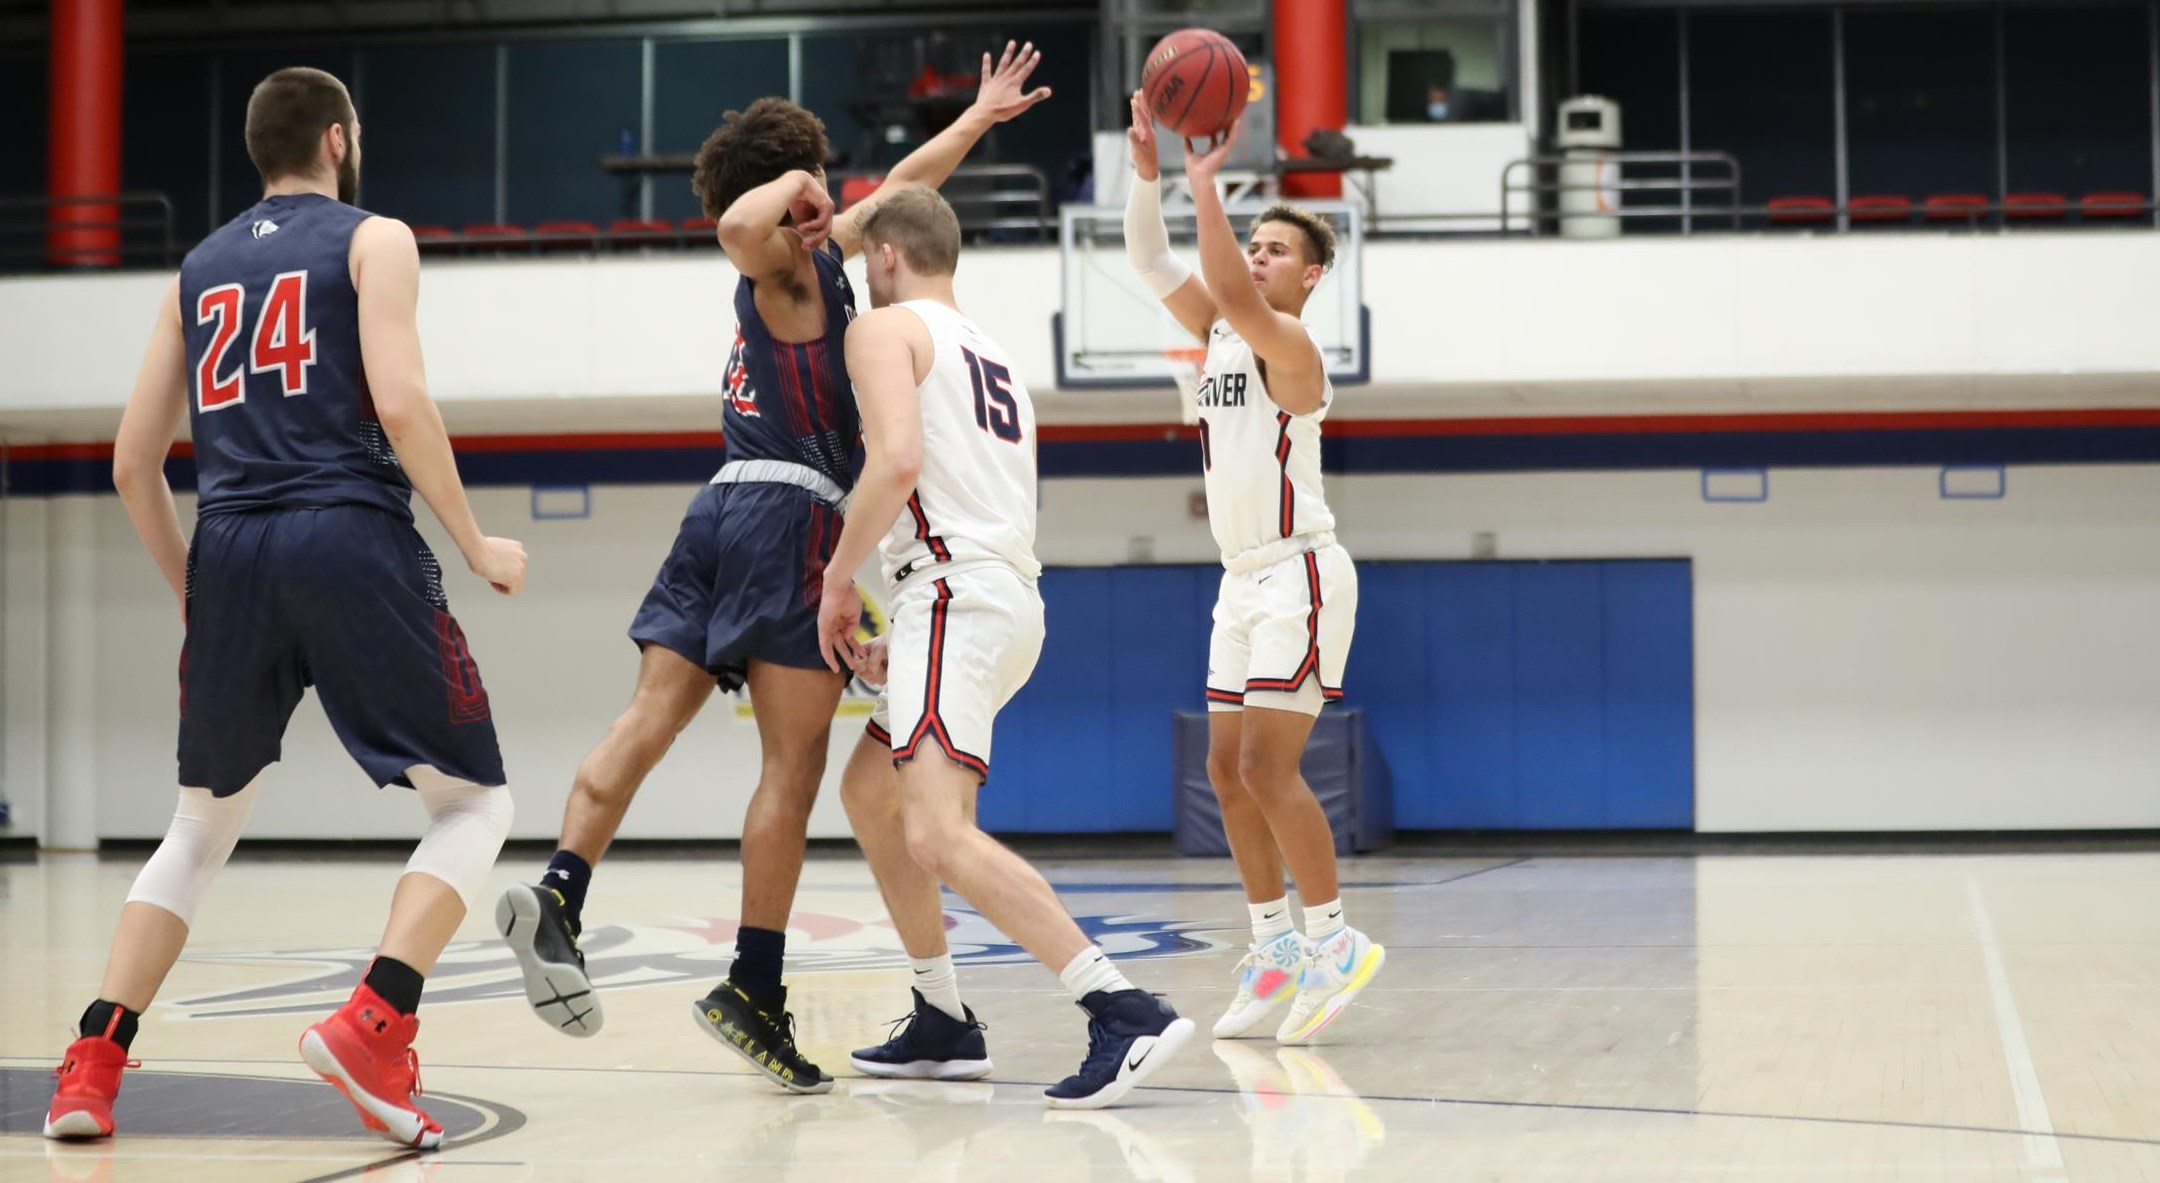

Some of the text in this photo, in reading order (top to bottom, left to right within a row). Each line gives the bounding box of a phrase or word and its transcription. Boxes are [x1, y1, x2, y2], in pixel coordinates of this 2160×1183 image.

[196, 269, 317, 414] 24
[959, 343, 1023, 446] 15
[706, 1007, 794, 1083] OAKLAND
